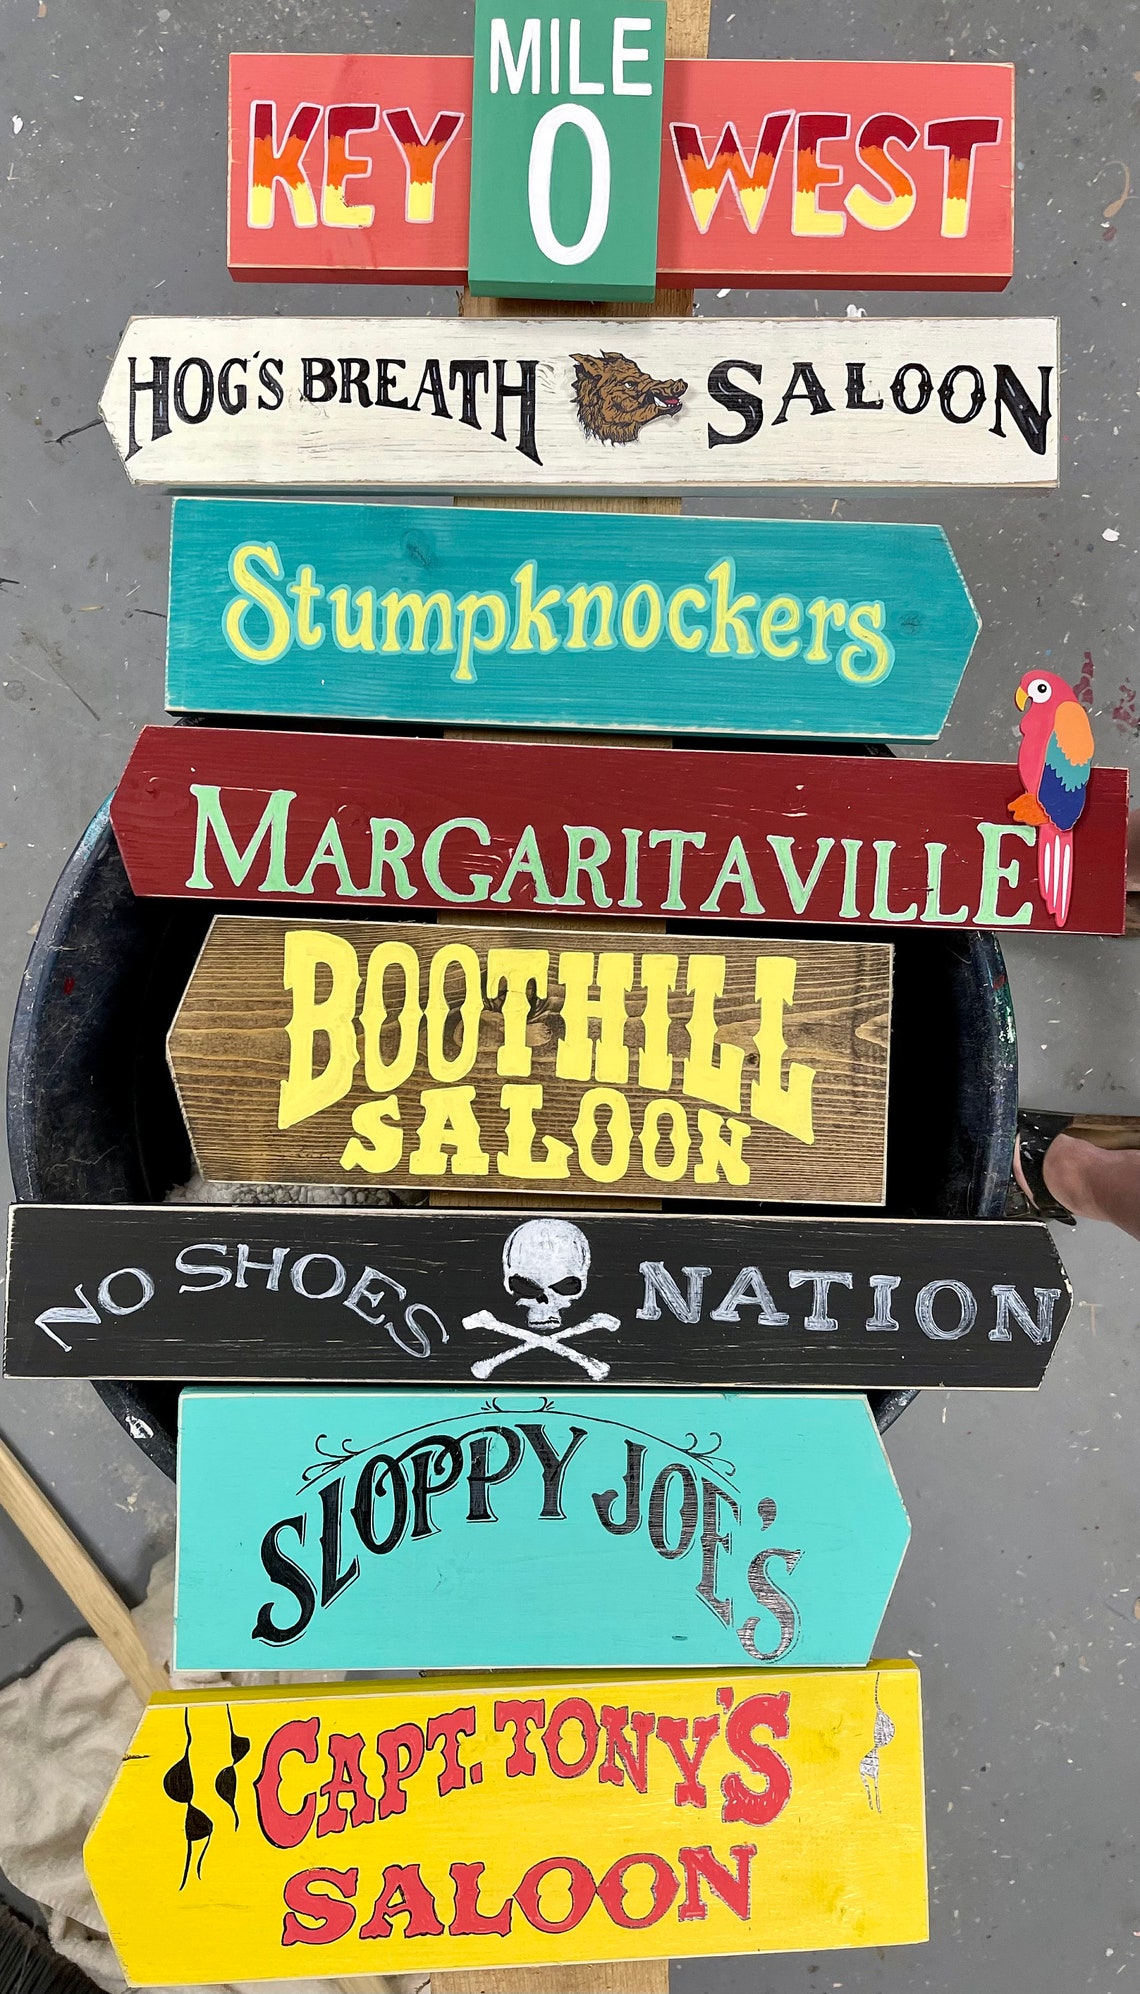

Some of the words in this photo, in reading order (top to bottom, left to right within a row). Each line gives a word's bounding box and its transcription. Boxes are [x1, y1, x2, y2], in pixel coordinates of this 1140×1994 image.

[489, 17, 653, 96] MILE
[247, 99, 465, 230] KEY
[669, 109, 1001, 239] WEST
[528, 103, 609, 266] 0
[126, 348, 285, 460] HOG'S
[299, 355, 543, 466] BREATH
[707, 359, 1055, 456] SALOON
[222, 540, 895, 685] Stumpknockers
[186, 783, 1038, 928] MARGARITAVILLE
[278, 929, 816, 1145] BOOTHILL
[340, 1083, 753, 1186] SALOON
[34, 1266, 156, 1352] NO
[175, 1242, 450, 1361] SHOES
[636, 1260, 1062, 1346] NATION
[251, 1423, 588, 1648] SLOPPY
[593, 1439, 803, 1665] JOE'S
[255, 1705, 482, 1849] CAPT.
[495, 1686, 792, 1827] TONY'S
[281, 1843, 757, 1947] SALOON
